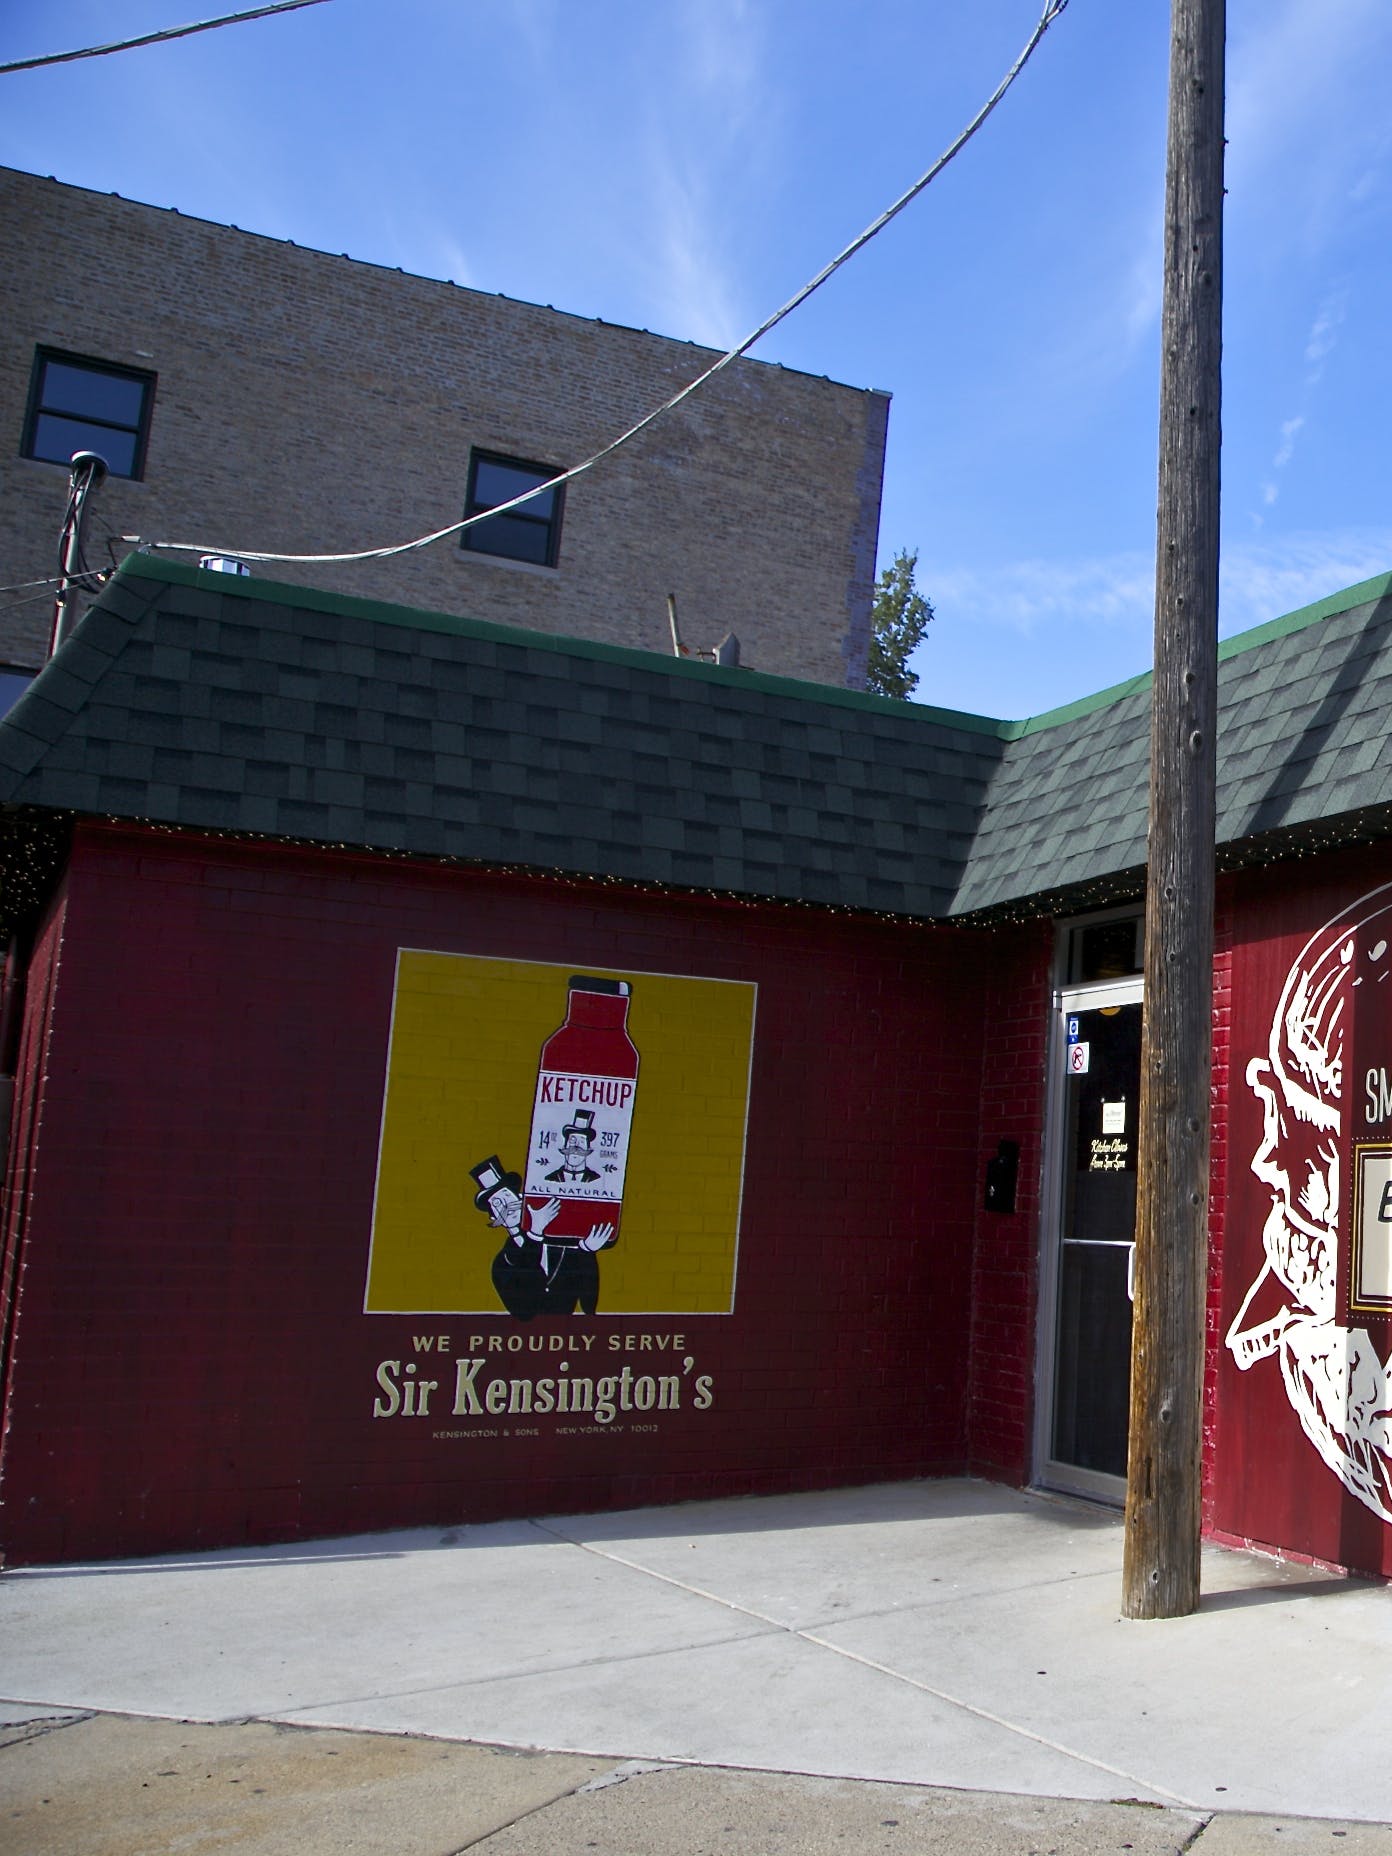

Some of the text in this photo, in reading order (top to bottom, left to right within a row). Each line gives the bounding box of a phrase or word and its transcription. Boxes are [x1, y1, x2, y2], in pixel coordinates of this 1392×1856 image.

[540, 1076, 632, 1109] KETCHUP
[600, 1131, 620, 1148] 397
[531, 1185, 616, 1198] ALL NATURAL
[412, 1334, 686, 1352] WE PROUDLY SERVE
[373, 1356, 713, 1423] Sir Kensington's
[432, 1429, 498, 1439] KENSINGTON
[514, 1428, 540, 1437] SONS
[555, 1426, 577, 1435] NEW
[610, 1425, 624, 1433] NY
